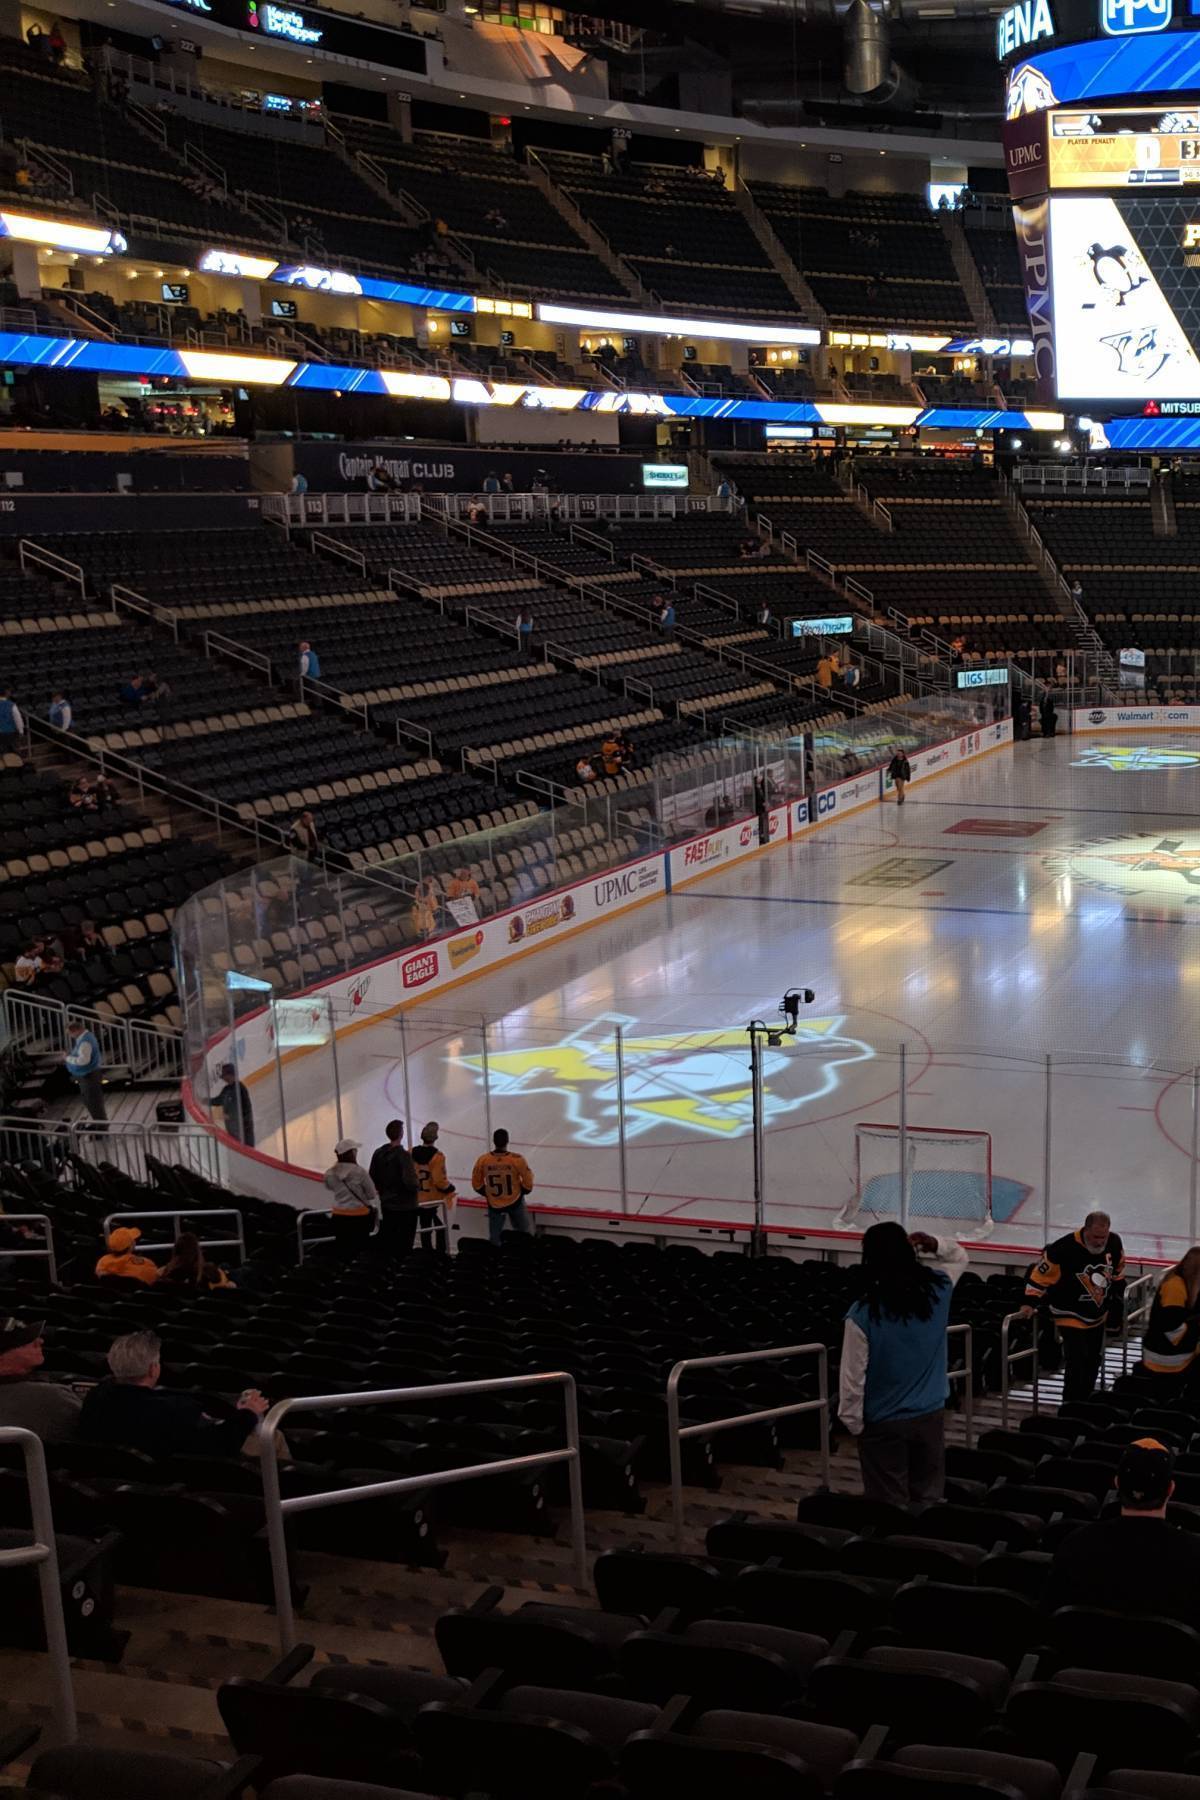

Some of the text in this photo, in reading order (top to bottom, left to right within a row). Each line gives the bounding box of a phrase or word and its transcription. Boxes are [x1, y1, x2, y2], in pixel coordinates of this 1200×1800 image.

[266, 5, 303, 27] Keurig
[1009, 142, 1041, 167] UPMC
[412, 463, 455, 479] CLUB
[1, 501, 16, 511] 112
[307, 501, 322, 513] 113
[391, 501, 405, 512] 113
[581, 502, 596, 511] 115
[691, 502, 706, 511] 115
[966, 672, 983, 685] IGS
[1117, 712, 1153, 721] Walmart
[798, 790, 836, 823] GCO
[595, 870, 638, 906] UPMC
[405, 954, 434, 974] GIANT
[407, 965, 435, 984] EAGLE
[488, 1174, 512, 1197] 51
[1106, 1252, 1113, 1265] C
